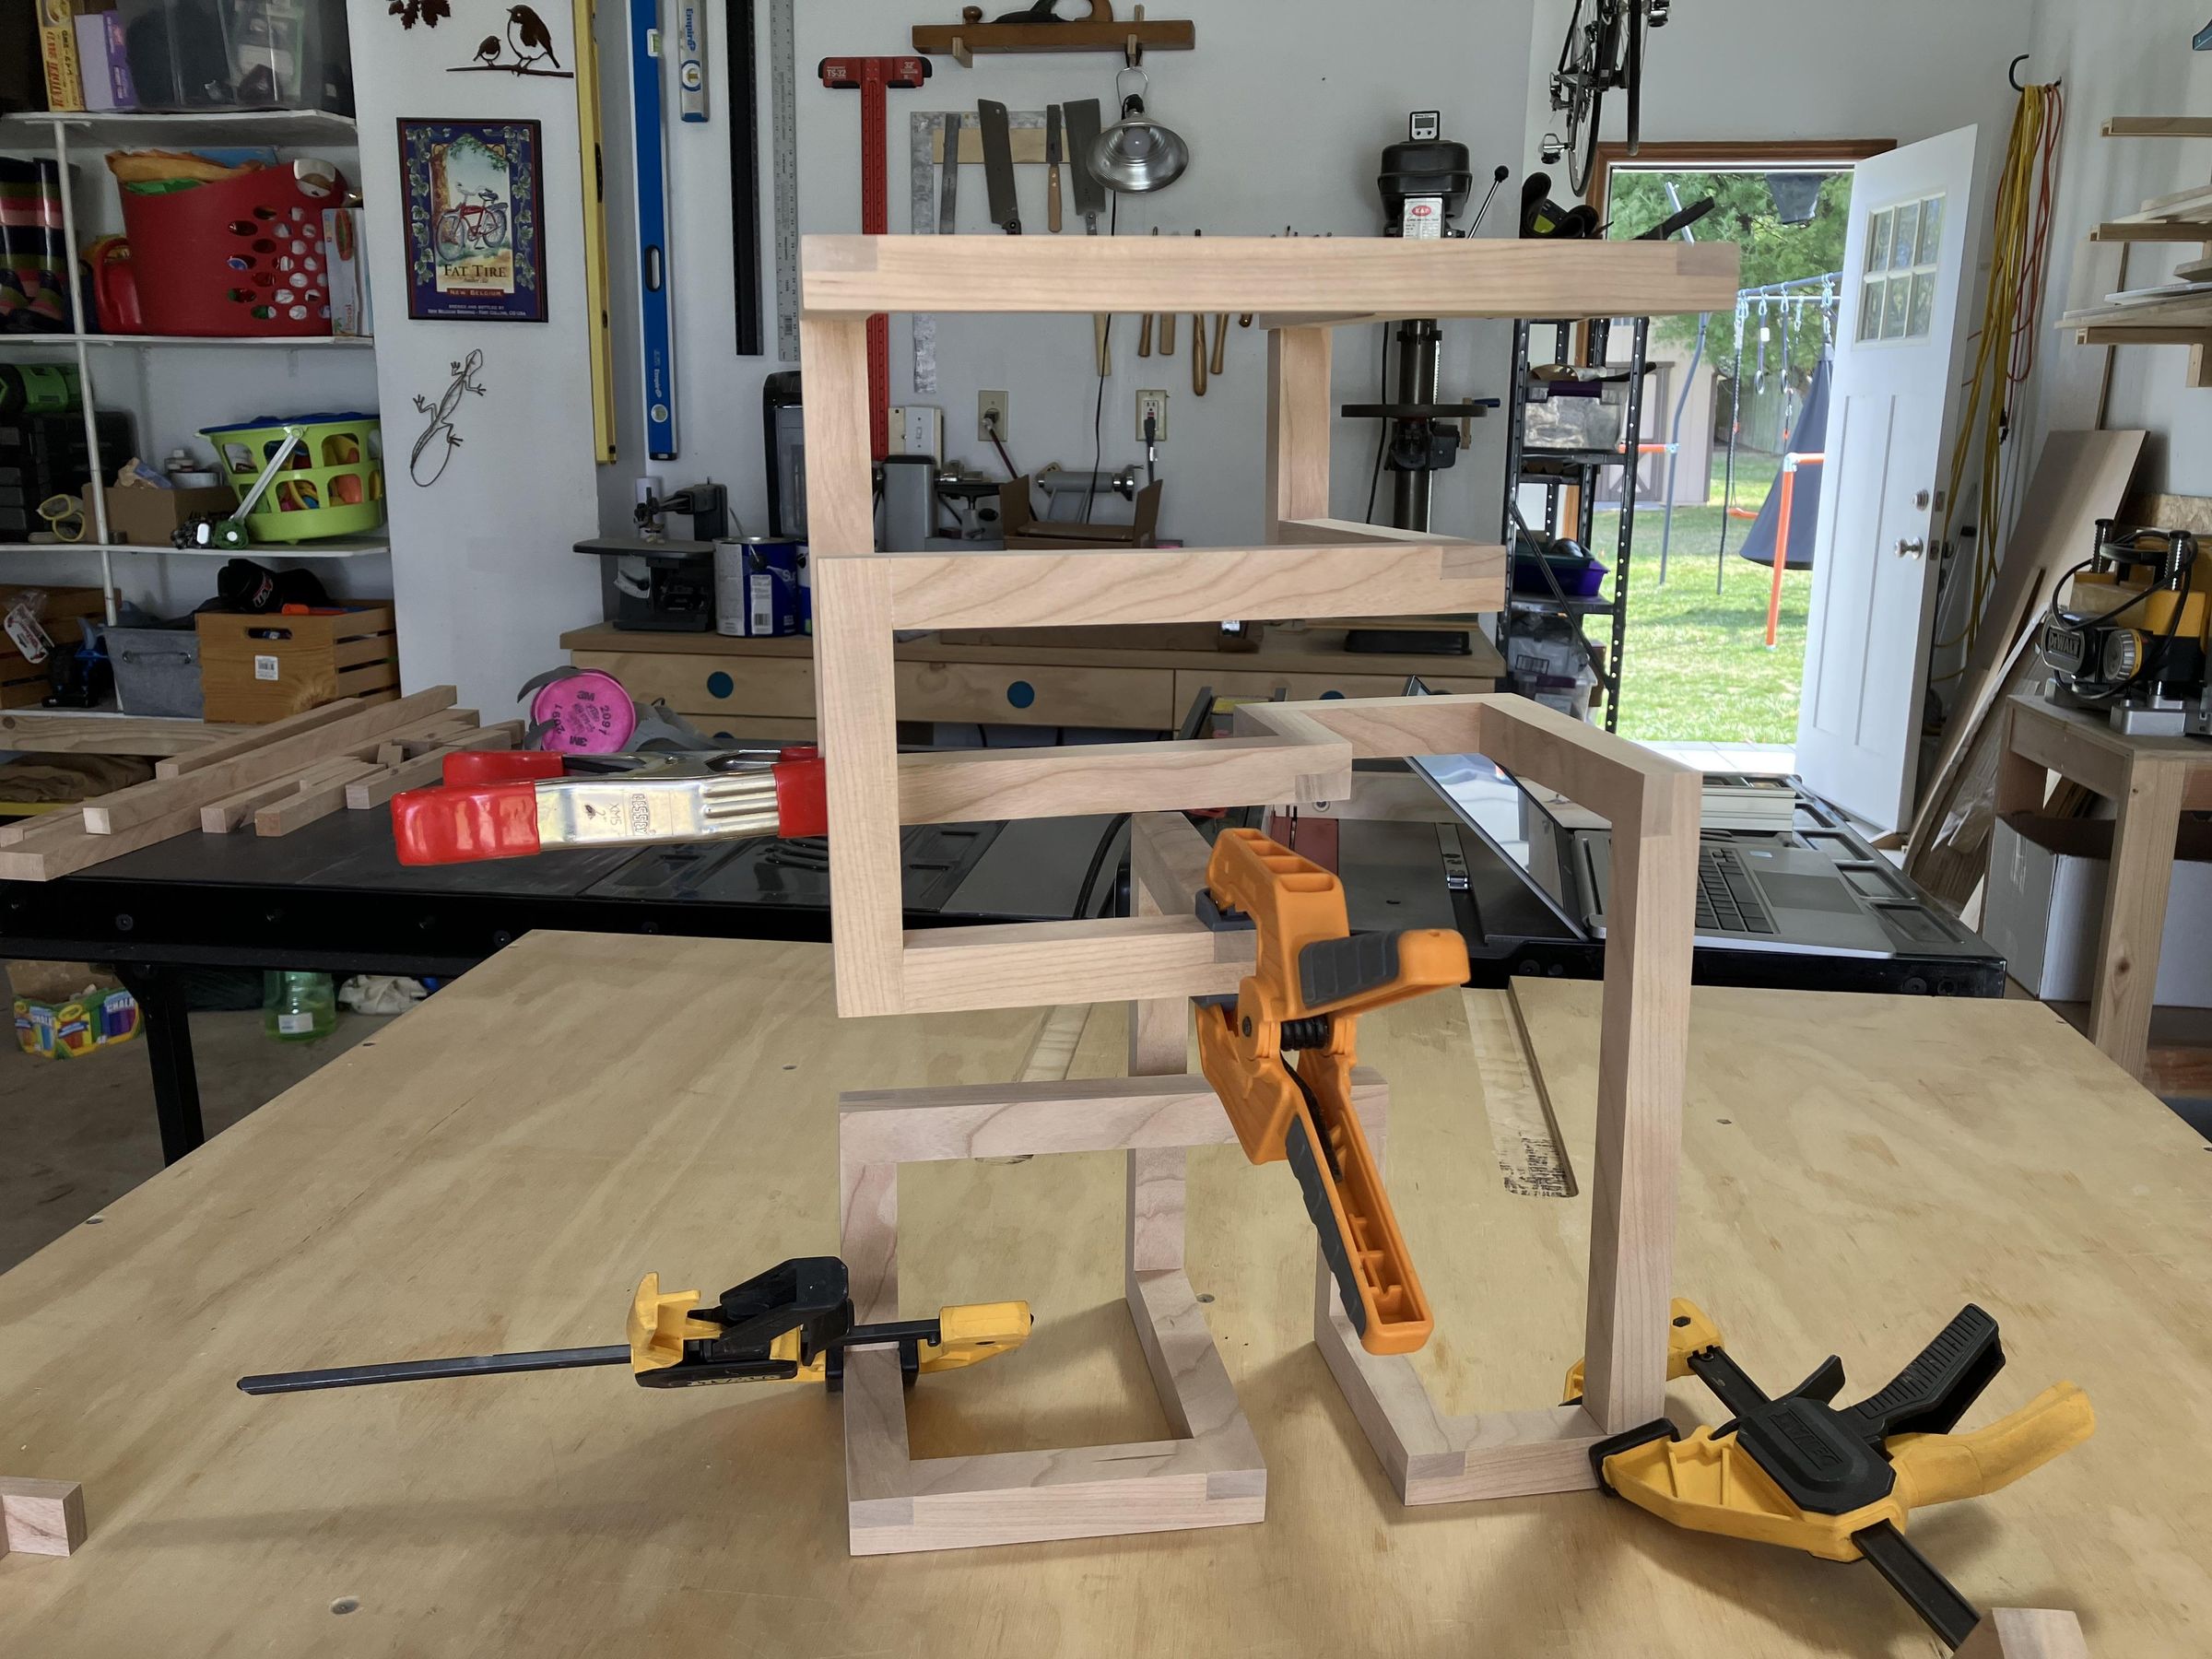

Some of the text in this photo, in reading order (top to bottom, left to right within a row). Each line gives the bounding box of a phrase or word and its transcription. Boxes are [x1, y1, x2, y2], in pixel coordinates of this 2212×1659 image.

[827, 69, 847, 77] TS-32
[444, 264, 506, 277] FAT TIRE
[577, 690, 595, 701] 3M
[598, 704, 612, 736] 2091
[569, 735, 588, 747] 3M
[631, 793, 649, 835] BESSEY
[105, 997, 135, 1014] CHALK
